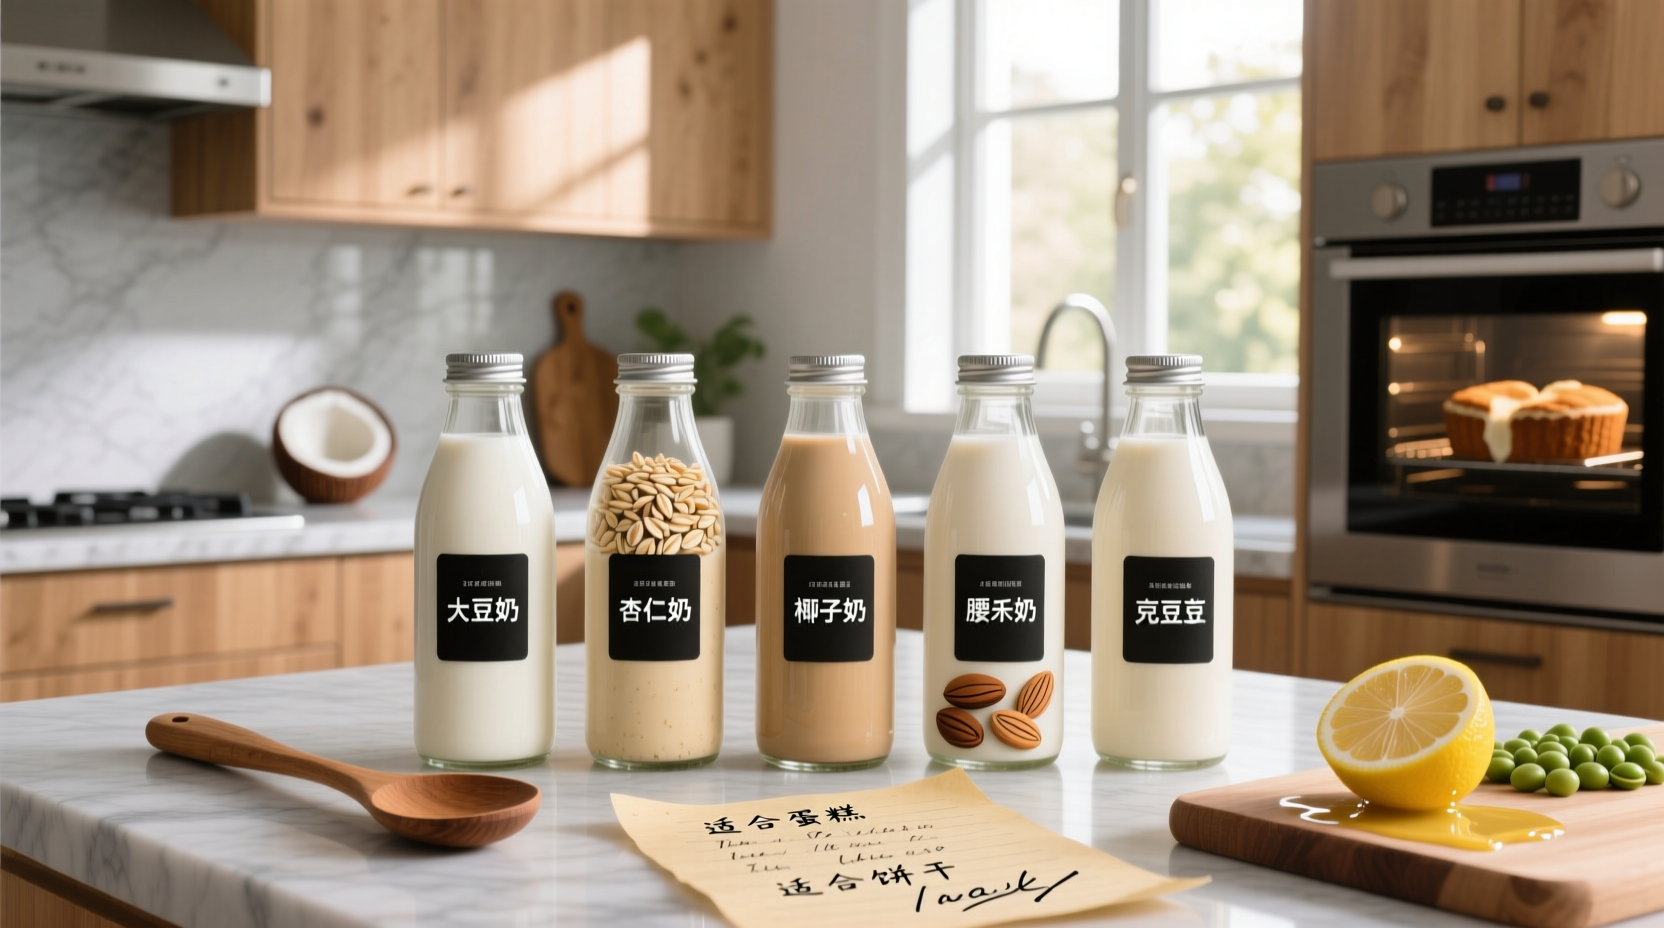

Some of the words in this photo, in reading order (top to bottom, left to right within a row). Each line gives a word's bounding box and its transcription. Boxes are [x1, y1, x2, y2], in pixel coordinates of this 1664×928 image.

[448, 597, 519, 623] 大豆奶
[619, 597, 692, 623] 杏仁奶
[704, 803, 866, 835] 适合蛋糕
[777, 861, 955, 897] 适合饼干
